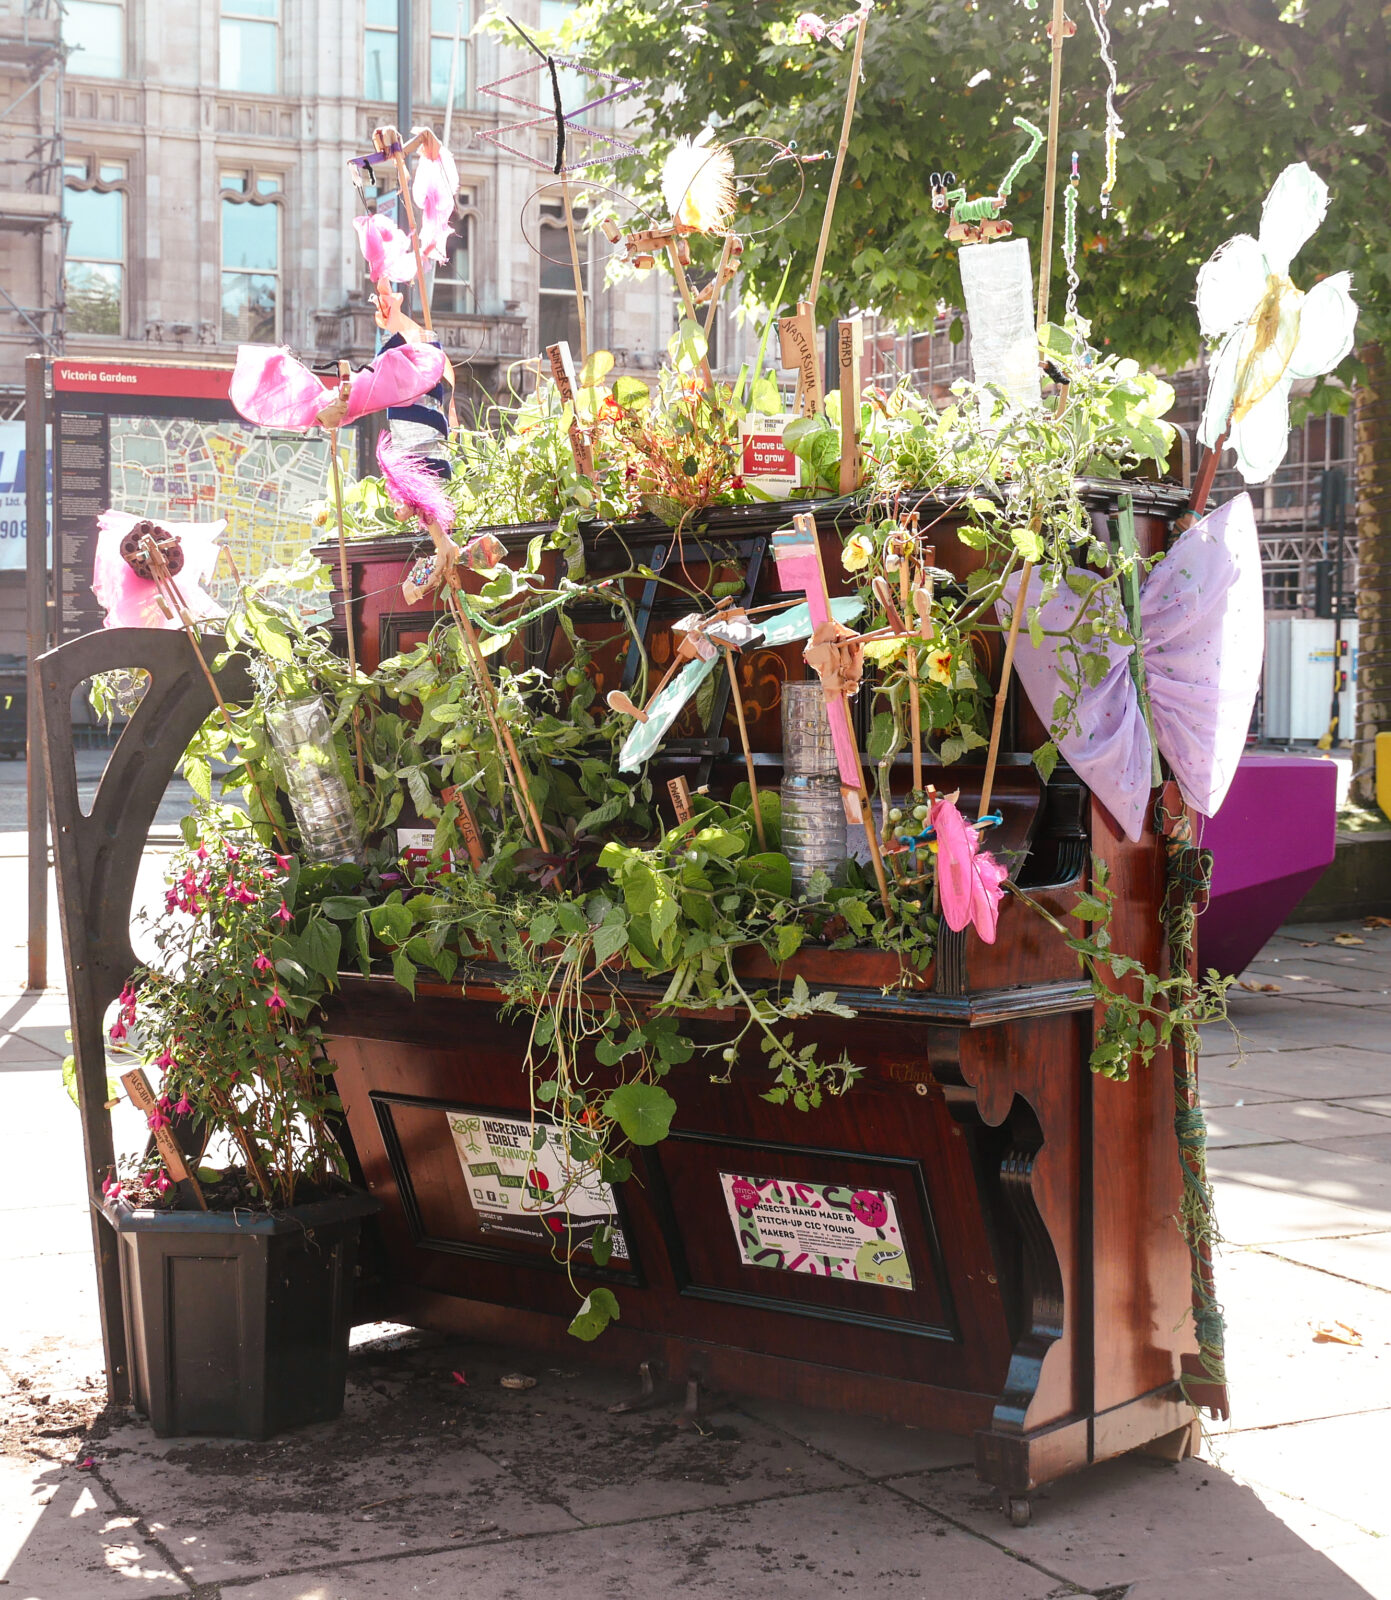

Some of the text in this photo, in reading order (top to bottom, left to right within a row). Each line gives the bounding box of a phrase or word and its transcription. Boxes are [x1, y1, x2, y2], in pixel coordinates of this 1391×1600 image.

[840, 327, 853, 368] CHARD
[782, 320, 816, 393] NASTURSIUM
[549, 346, 569, 386] WINTER
[60, 370, 138, 384] Victoria Gardens
[752, 440, 775, 450] Leave
[754, 452, 785, 464] to grow
[669, 781, 685, 811] DWARF
[486, 1133, 521, 1148] EDIBLE
[471, 1165, 491, 1176] PLANT
[734, 1187, 757, 1195] STITCH
[754, 1202, 857, 1223] INSECTS HAND MADE BY
[757, 1215, 855, 1235] STITCH-UP CIC YOUNG
[760, 1228, 796, 1239] MAKERS
